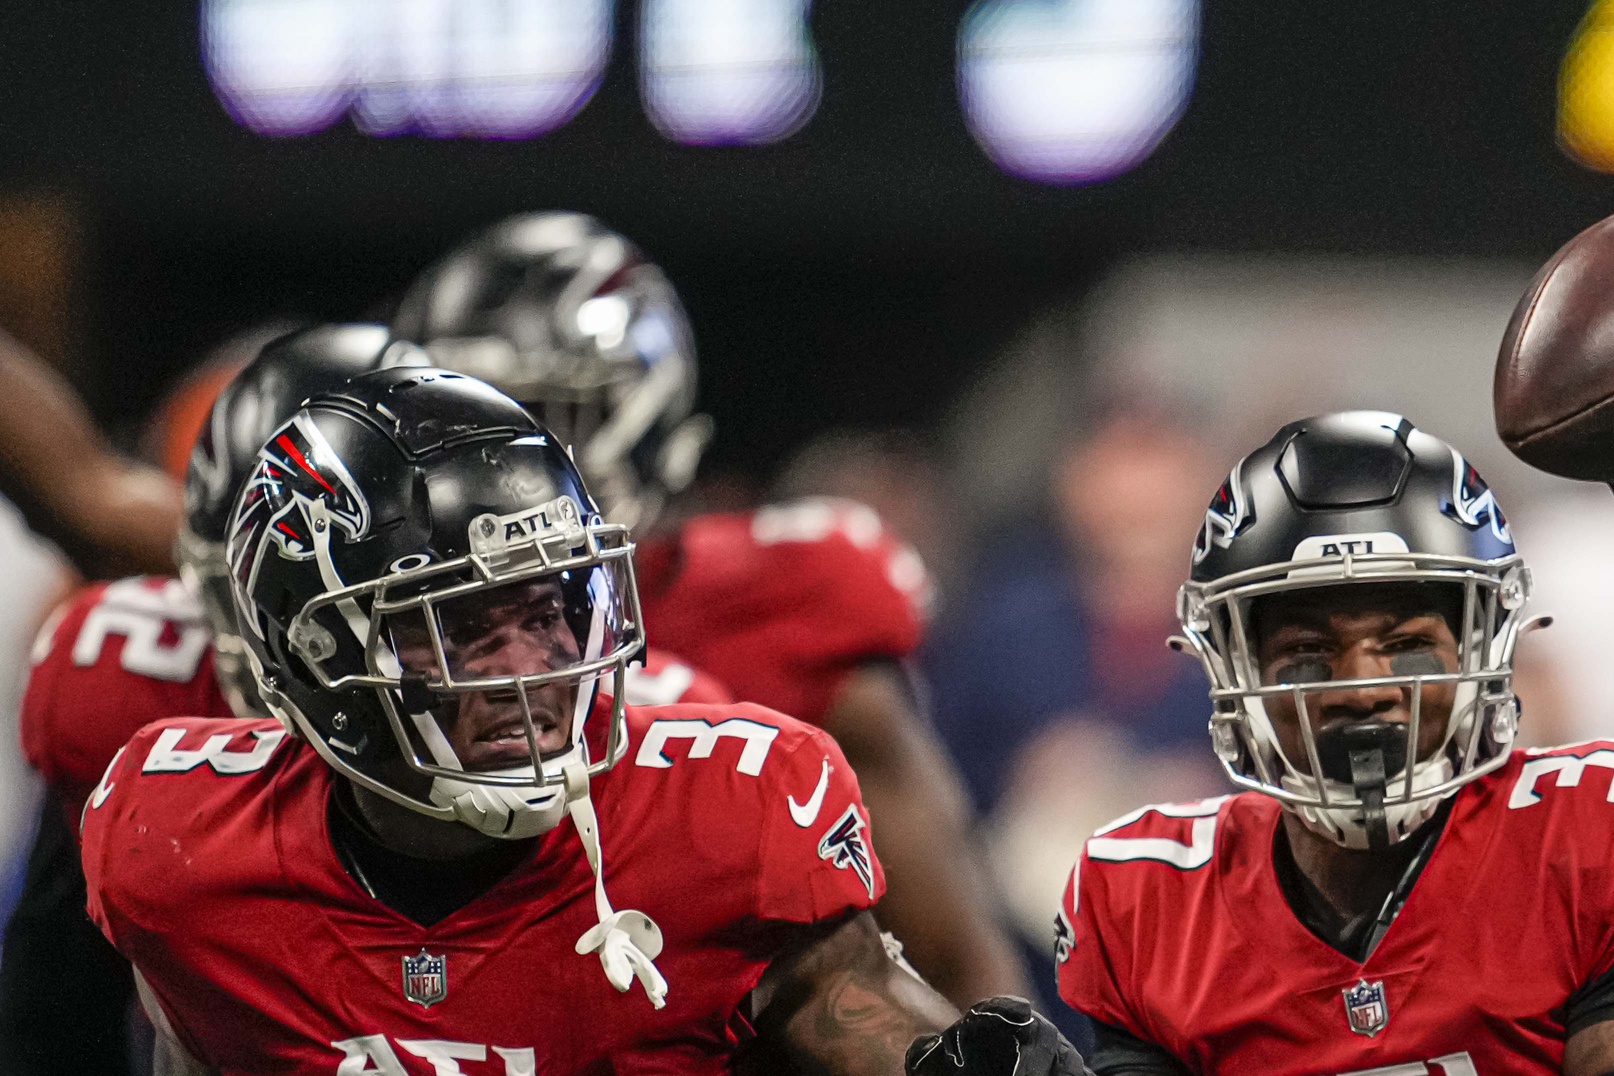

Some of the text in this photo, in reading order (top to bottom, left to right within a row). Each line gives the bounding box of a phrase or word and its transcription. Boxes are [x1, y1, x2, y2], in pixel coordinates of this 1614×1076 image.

[504, 511, 552, 540] ATL
[141, 728, 287, 776] 3
[635, 717, 781, 777] 3
[410, 976, 440, 998] NFL
